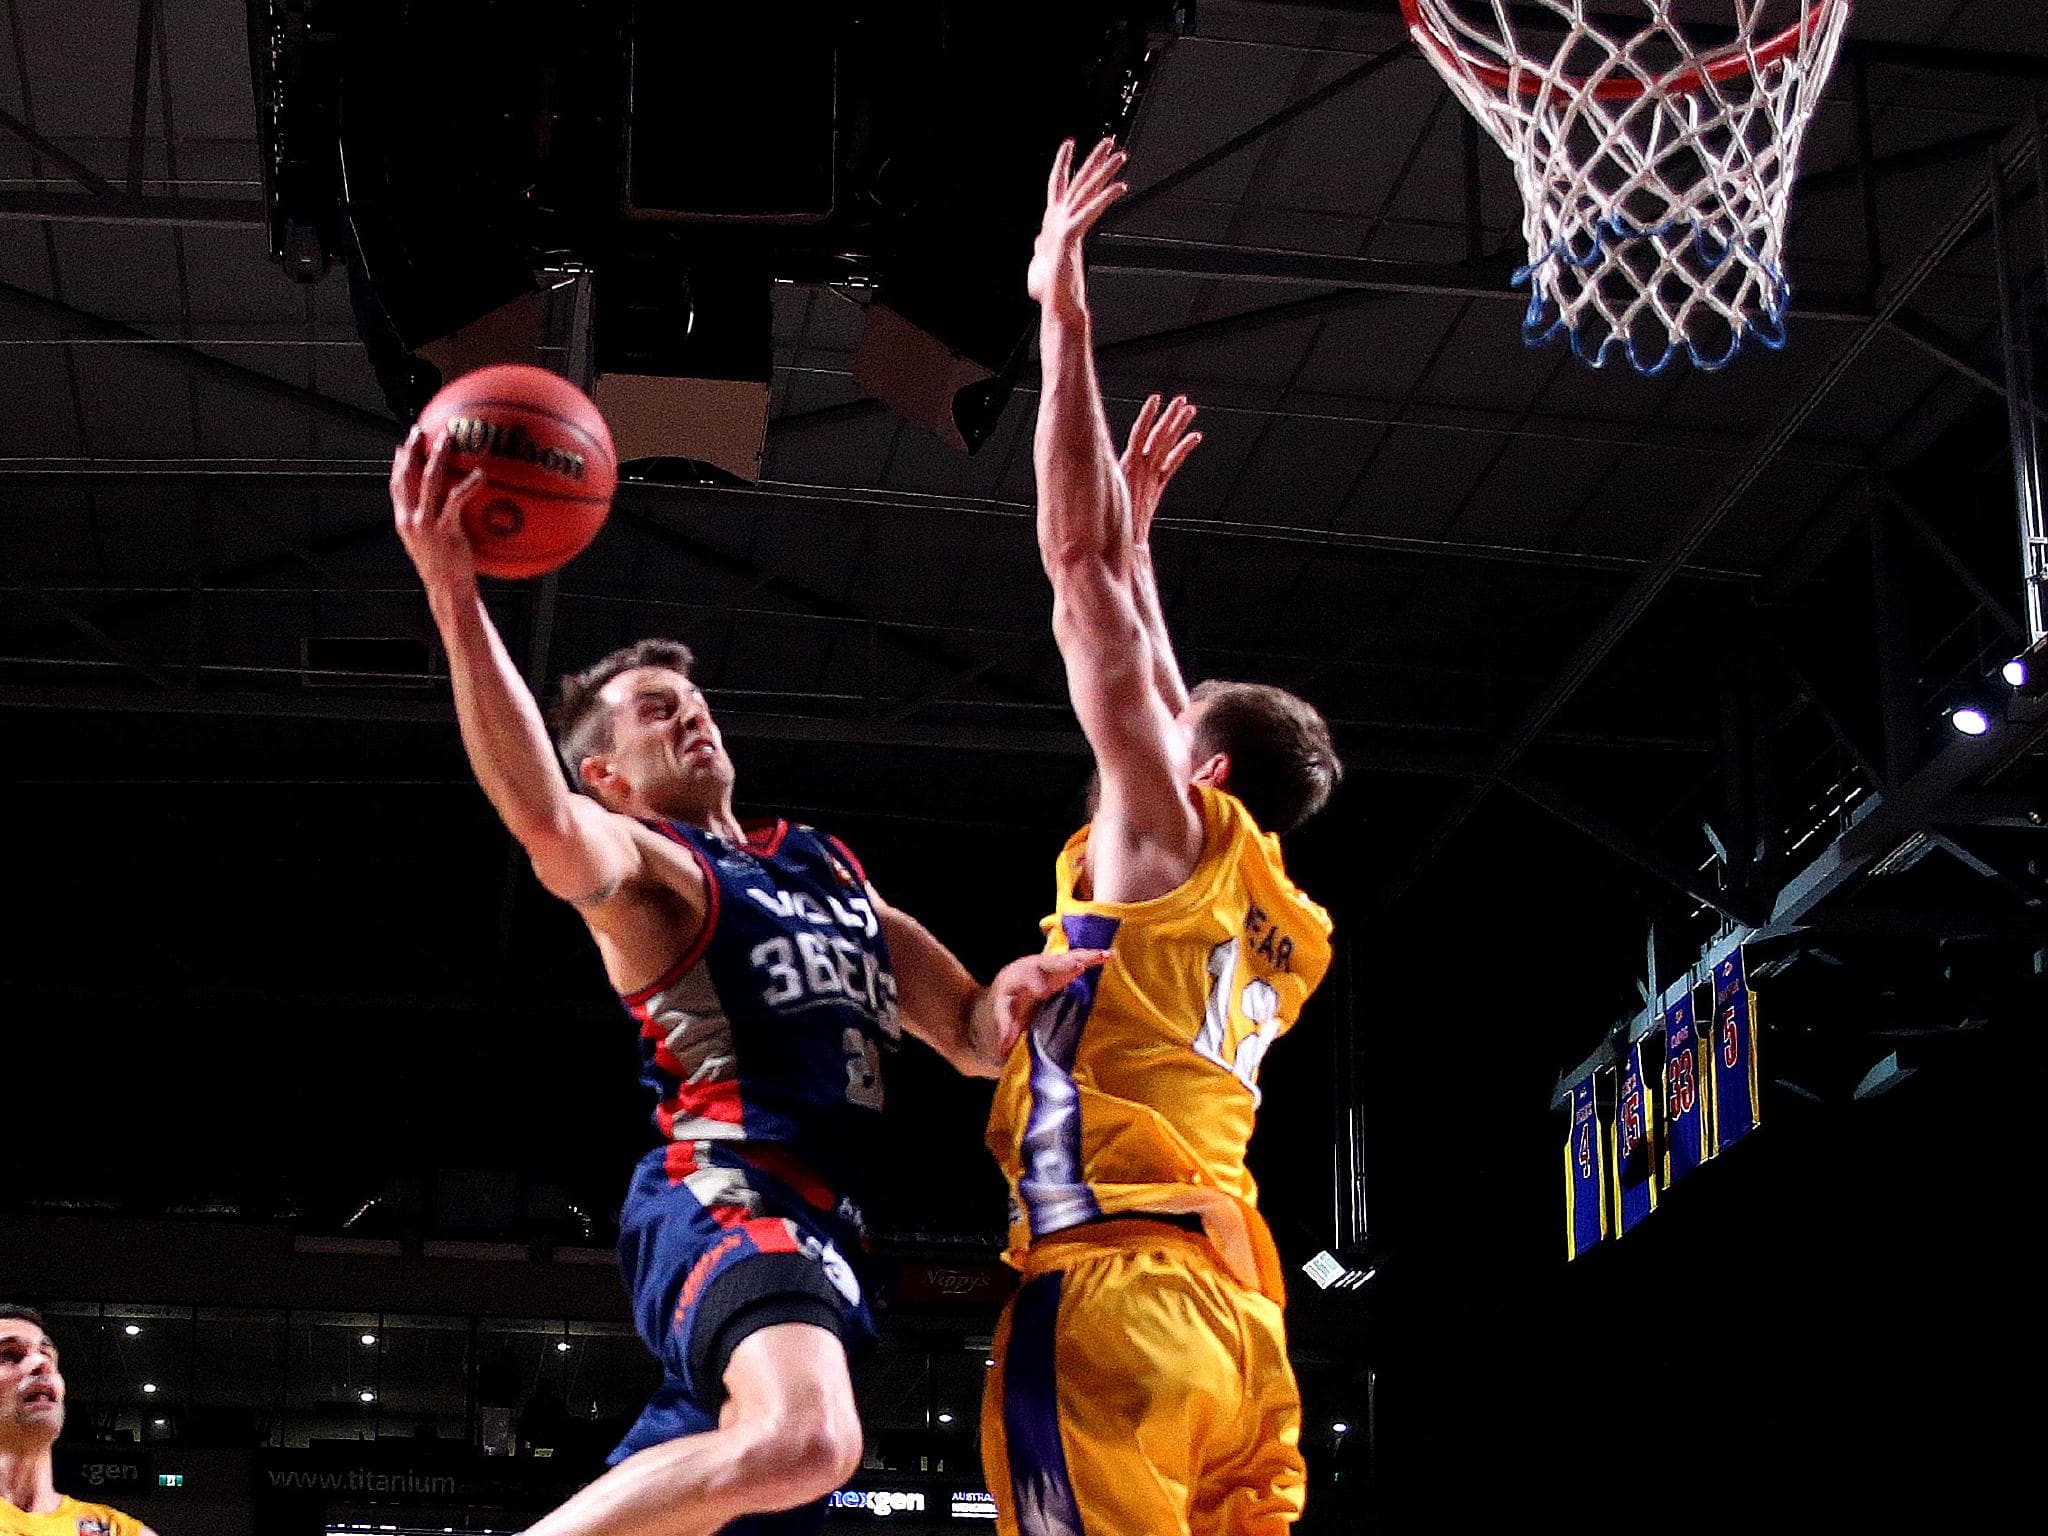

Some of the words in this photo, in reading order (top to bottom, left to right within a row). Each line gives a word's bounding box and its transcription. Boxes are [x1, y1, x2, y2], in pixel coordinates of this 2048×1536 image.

[1244, 905, 1294, 974] EAR
[1722, 1006, 1738, 1068] 5
[1669, 1048, 1695, 1122] 33
[1579, 1122, 1591, 1179] 4
[829, 1490, 925, 1516] nexgen
